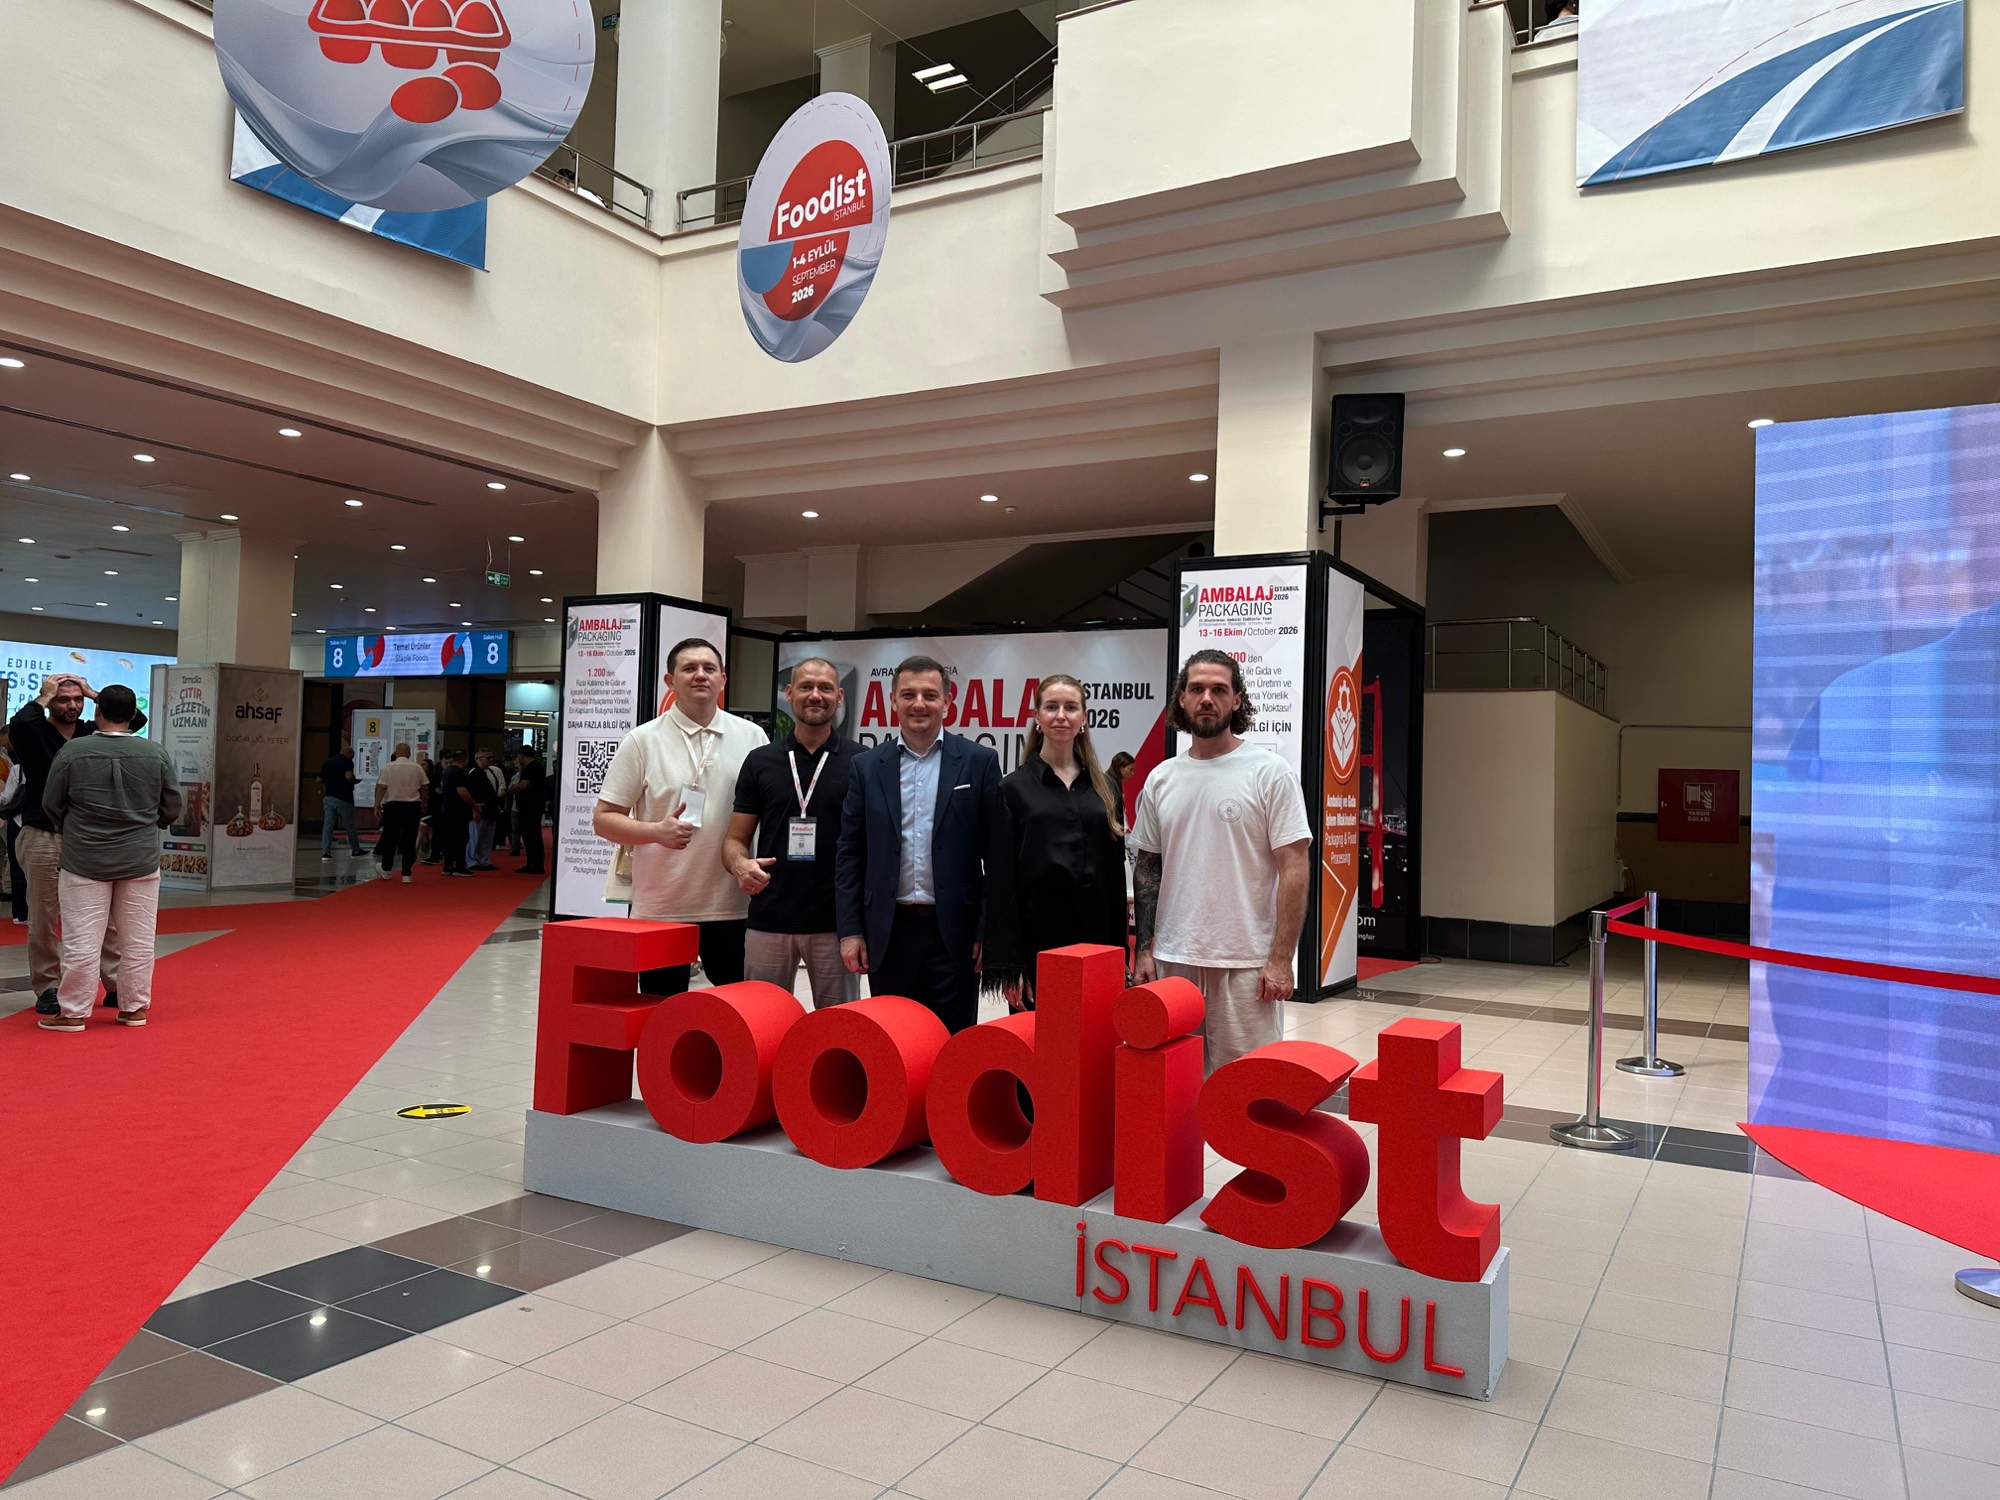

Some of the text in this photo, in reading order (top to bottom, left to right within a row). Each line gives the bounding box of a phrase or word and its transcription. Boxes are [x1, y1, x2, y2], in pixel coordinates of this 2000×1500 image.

[777, 167, 867, 236] Foodist
[792, 239, 837, 270] 1-4 EYLÜL
[791, 258, 836, 287] SEPTEMBER
[791, 284, 814, 304] 2026
[1200, 584, 1274, 603] AMBALAJ
[1274, 593, 1289, 601] 2026
[1199, 602, 1273, 617] PACKAGING
[579, 618, 623, 631] AMBALAJ
[482, 633, 495, 641] Salon
[578, 631, 621, 641] PACKAGING
[1199, 629, 1208, 637] 13
[1213, 628, 1222, 637] 16
[1278, 626, 1298, 635] 2026
[393, 641, 431, 651] Temel Ürünler
[333, 647, 343, 668] 8
[395, 654, 429, 663] Staple Foods
[486, 642, 499, 665] 8
[7, 656, 52, 671] EDIBLE
[588, 668, 605, 677] 1.200
[1255, 666, 1272, 675] Gıda
[1257, 677, 1282, 688] Üretim
[1262, 690, 1289, 700] Yönelik
[170, 701, 211, 716] LEZZETİN
[235, 702, 283, 724] ahsaf
[172, 716, 207, 728] UZMANI
[1086, 708, 1120, 729] 026
[369, 721, 376, 733] 8
[568, 719, 631, 731] DAHA FAZLA BİLGİ İÇİN
[1271, 720, 1292, 734] İÇİN
[267, 737, 289, 745] YETER
[565, 805, 576, 814] FOR
[576, 806, 592, 814] MORE
[570, 827, 593, 837] Exhibitors
[561, 837, 596, 846] Comprehensive
[580, 847, 593, 855] Food
[588, 857, 611, 866] Productio
[572, 866, 597, 875] Packaging
[532, 918, 1504, 1284] Foodist
[1075, 1220, 1465, 1381] İSTANBUL
